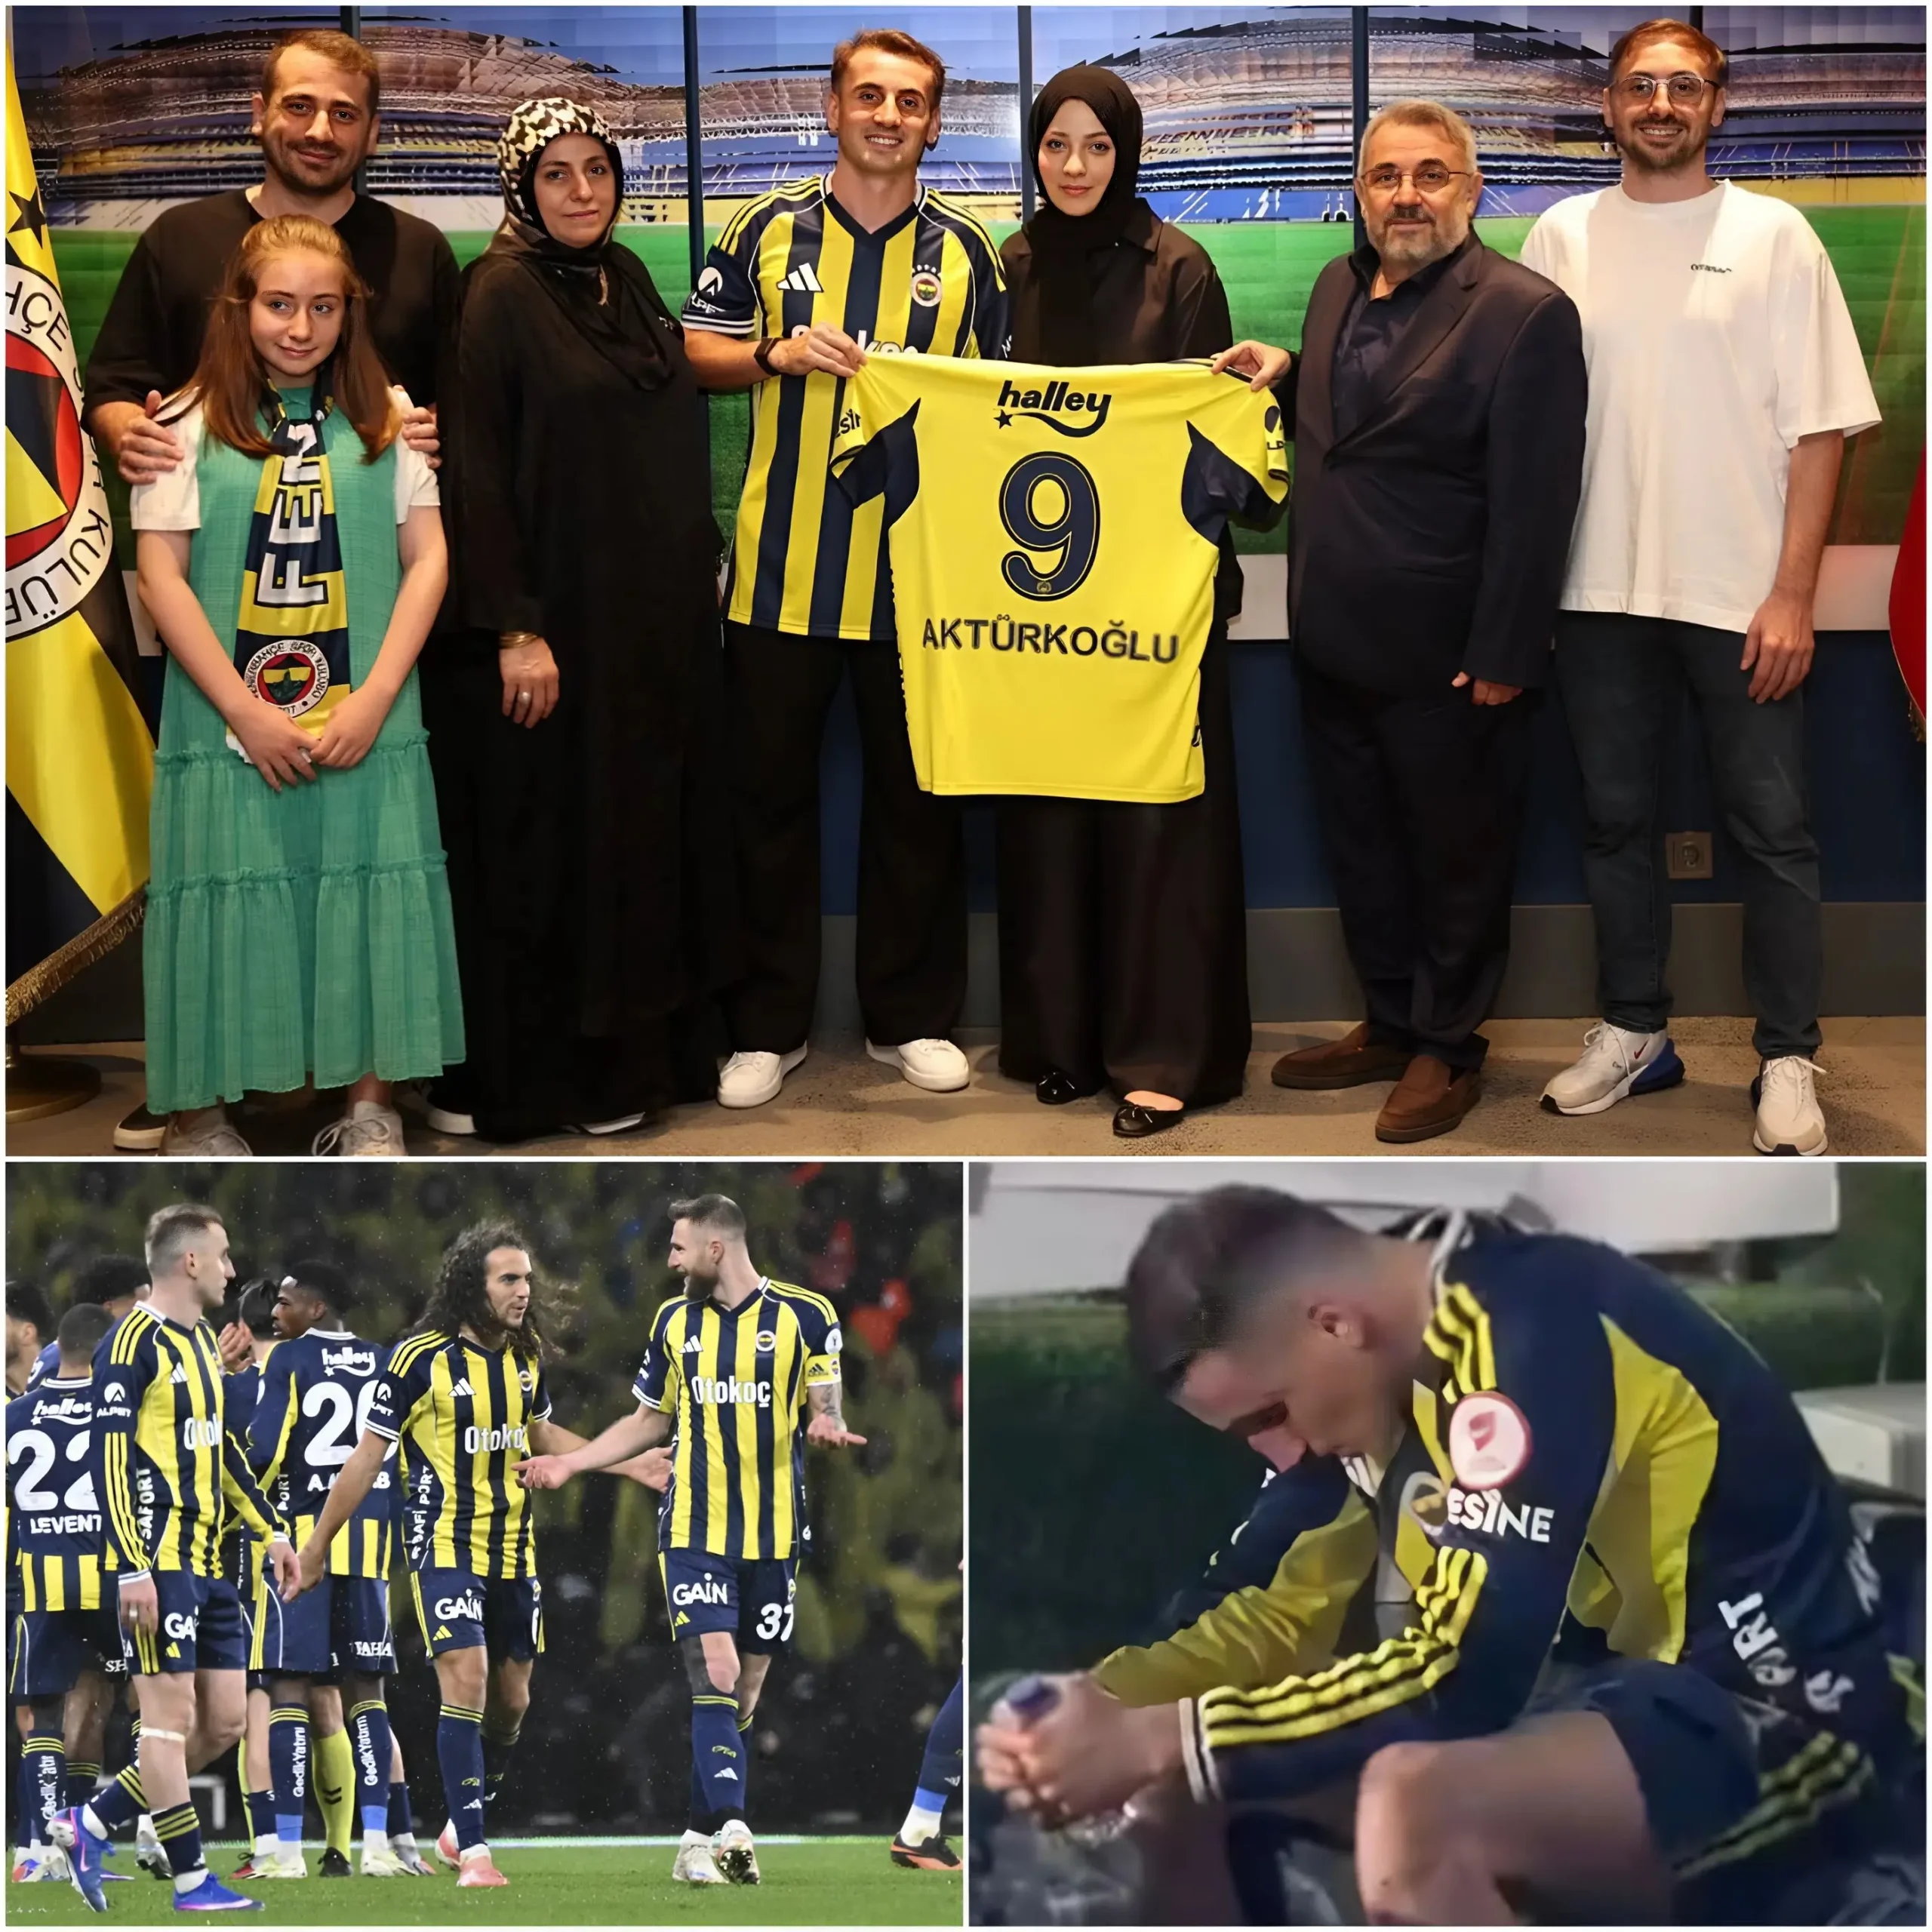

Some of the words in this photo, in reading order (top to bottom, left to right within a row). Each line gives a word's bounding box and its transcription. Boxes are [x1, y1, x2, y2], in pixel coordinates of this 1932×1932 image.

[998, 380, 1112, 438] halley
[998, 451, 1101, 602] 9
[922, 614, 1179, 664] AKTÜRKOĞLU
[691, 1375, 771, 1407] Otokoç
[464, 1423, 527, 1454] Otoko
